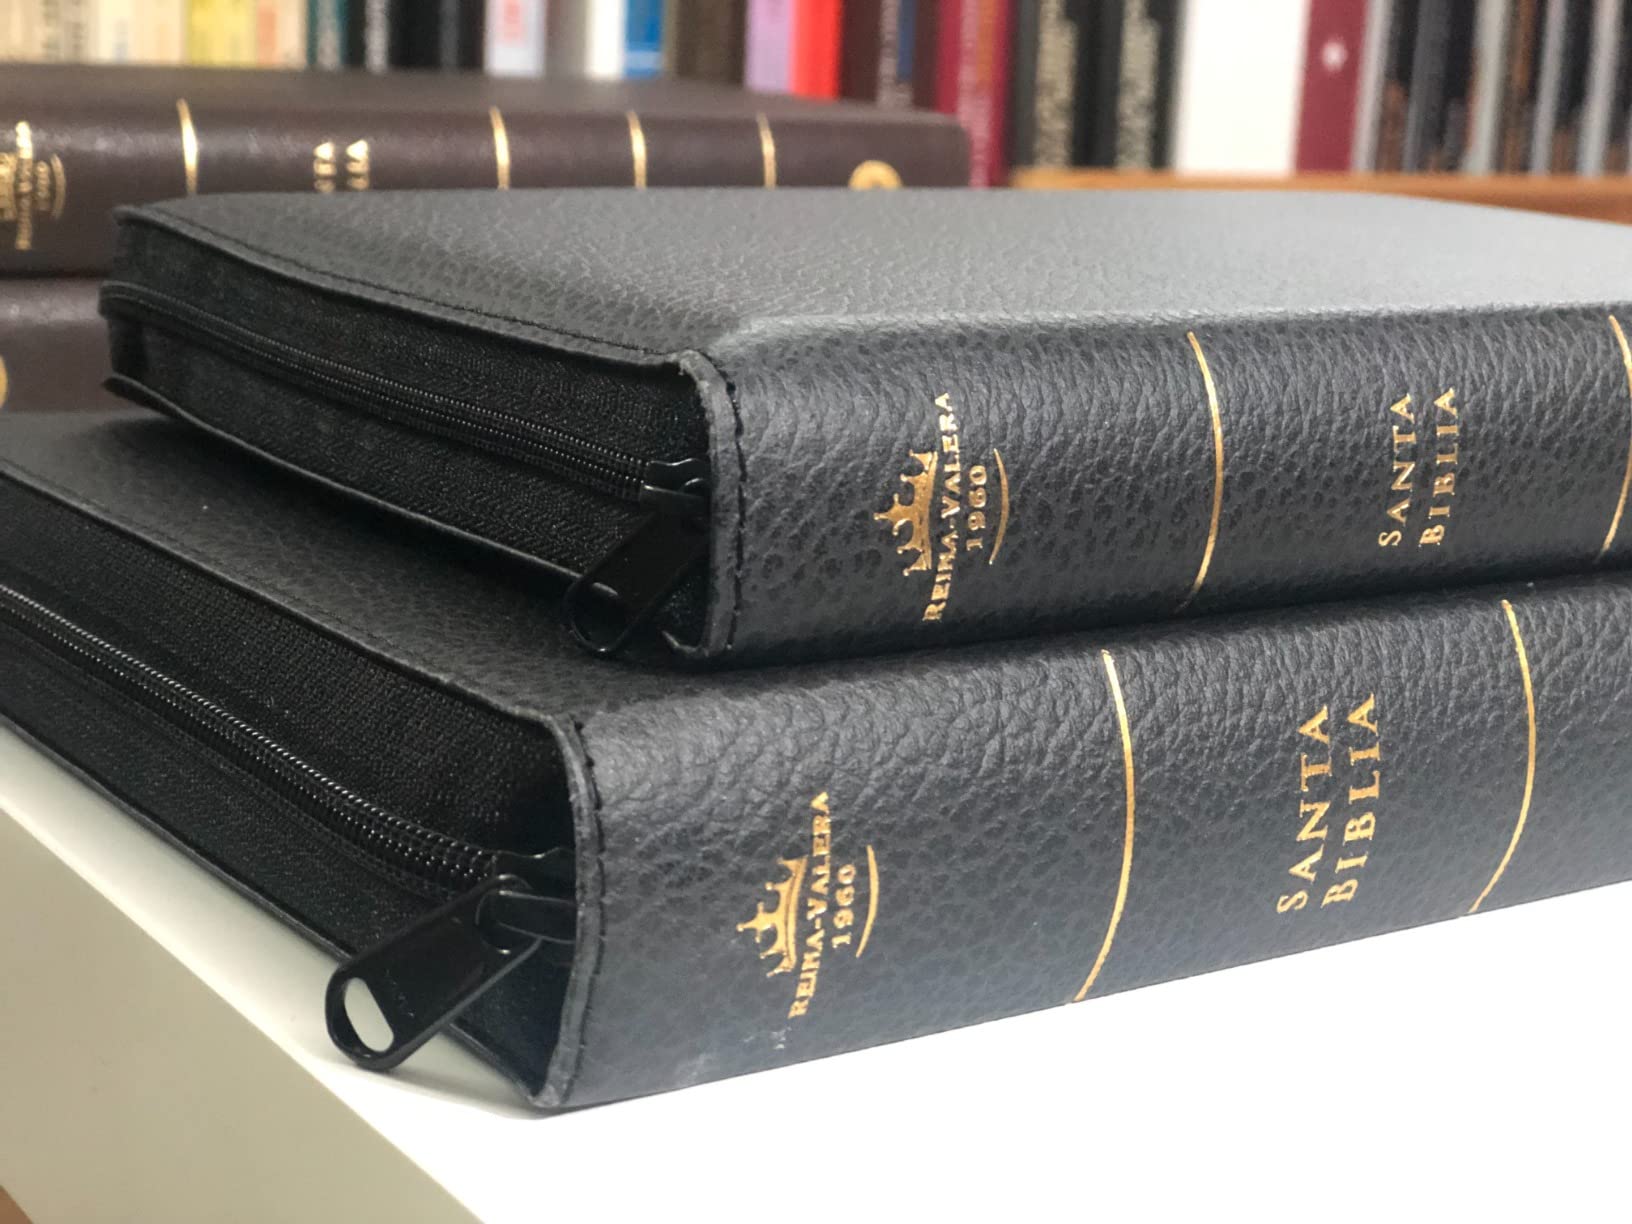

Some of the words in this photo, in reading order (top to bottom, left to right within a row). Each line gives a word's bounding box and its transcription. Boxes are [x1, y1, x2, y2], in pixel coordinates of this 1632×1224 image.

[923, 393, 961, 623] REINA-VALERA
[966, 464, 988, 552] 1960
[1378, 393, 1416, 547] SANTA
[1420, 388, 1460, 546] BIBLIA
[1276, 704, 1332, 914] SANTA
[1321, 693, 1380, 907] BIBLIA
[788, 791, 832, 1018] REINA-VALERA
[831, 863, 857, 948] 1960
